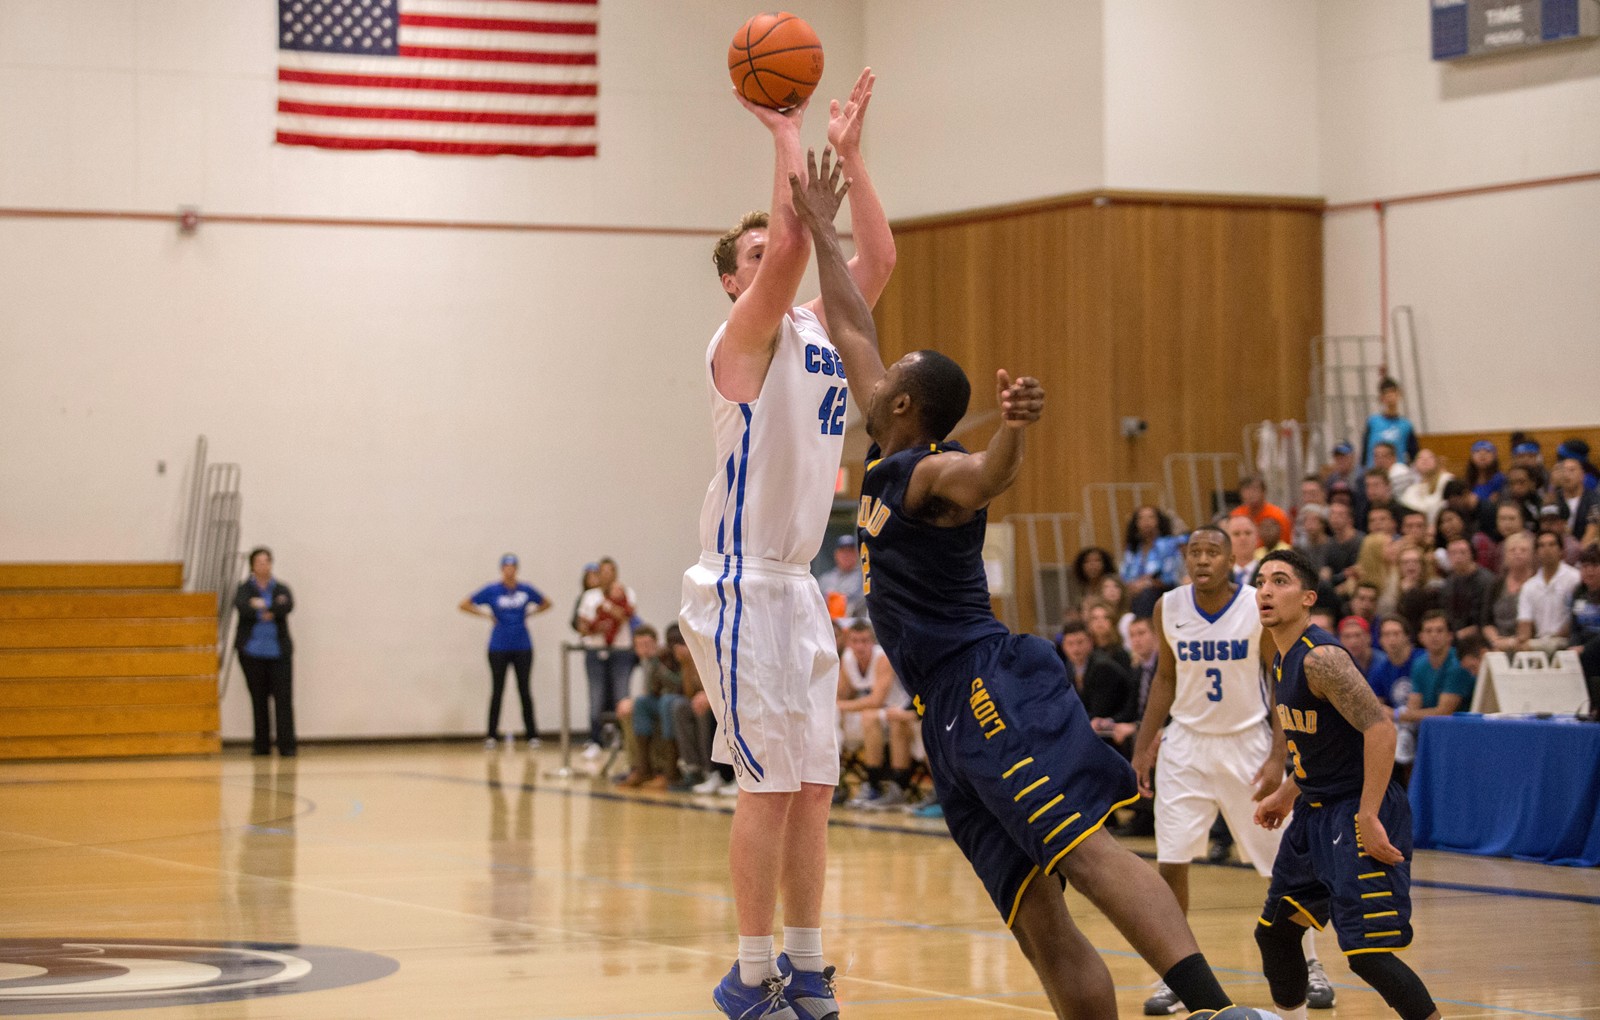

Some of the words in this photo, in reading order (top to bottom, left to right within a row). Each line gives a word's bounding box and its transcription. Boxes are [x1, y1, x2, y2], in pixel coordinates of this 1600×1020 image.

[818, 386, 848, 436] 42
[1177, 638, 1249, 661] CSUSM
[1205, 667, 1223, 702] 3
[969, 677, 1006, 740] LIONS
[1287, 739, 1307, 778] 3
